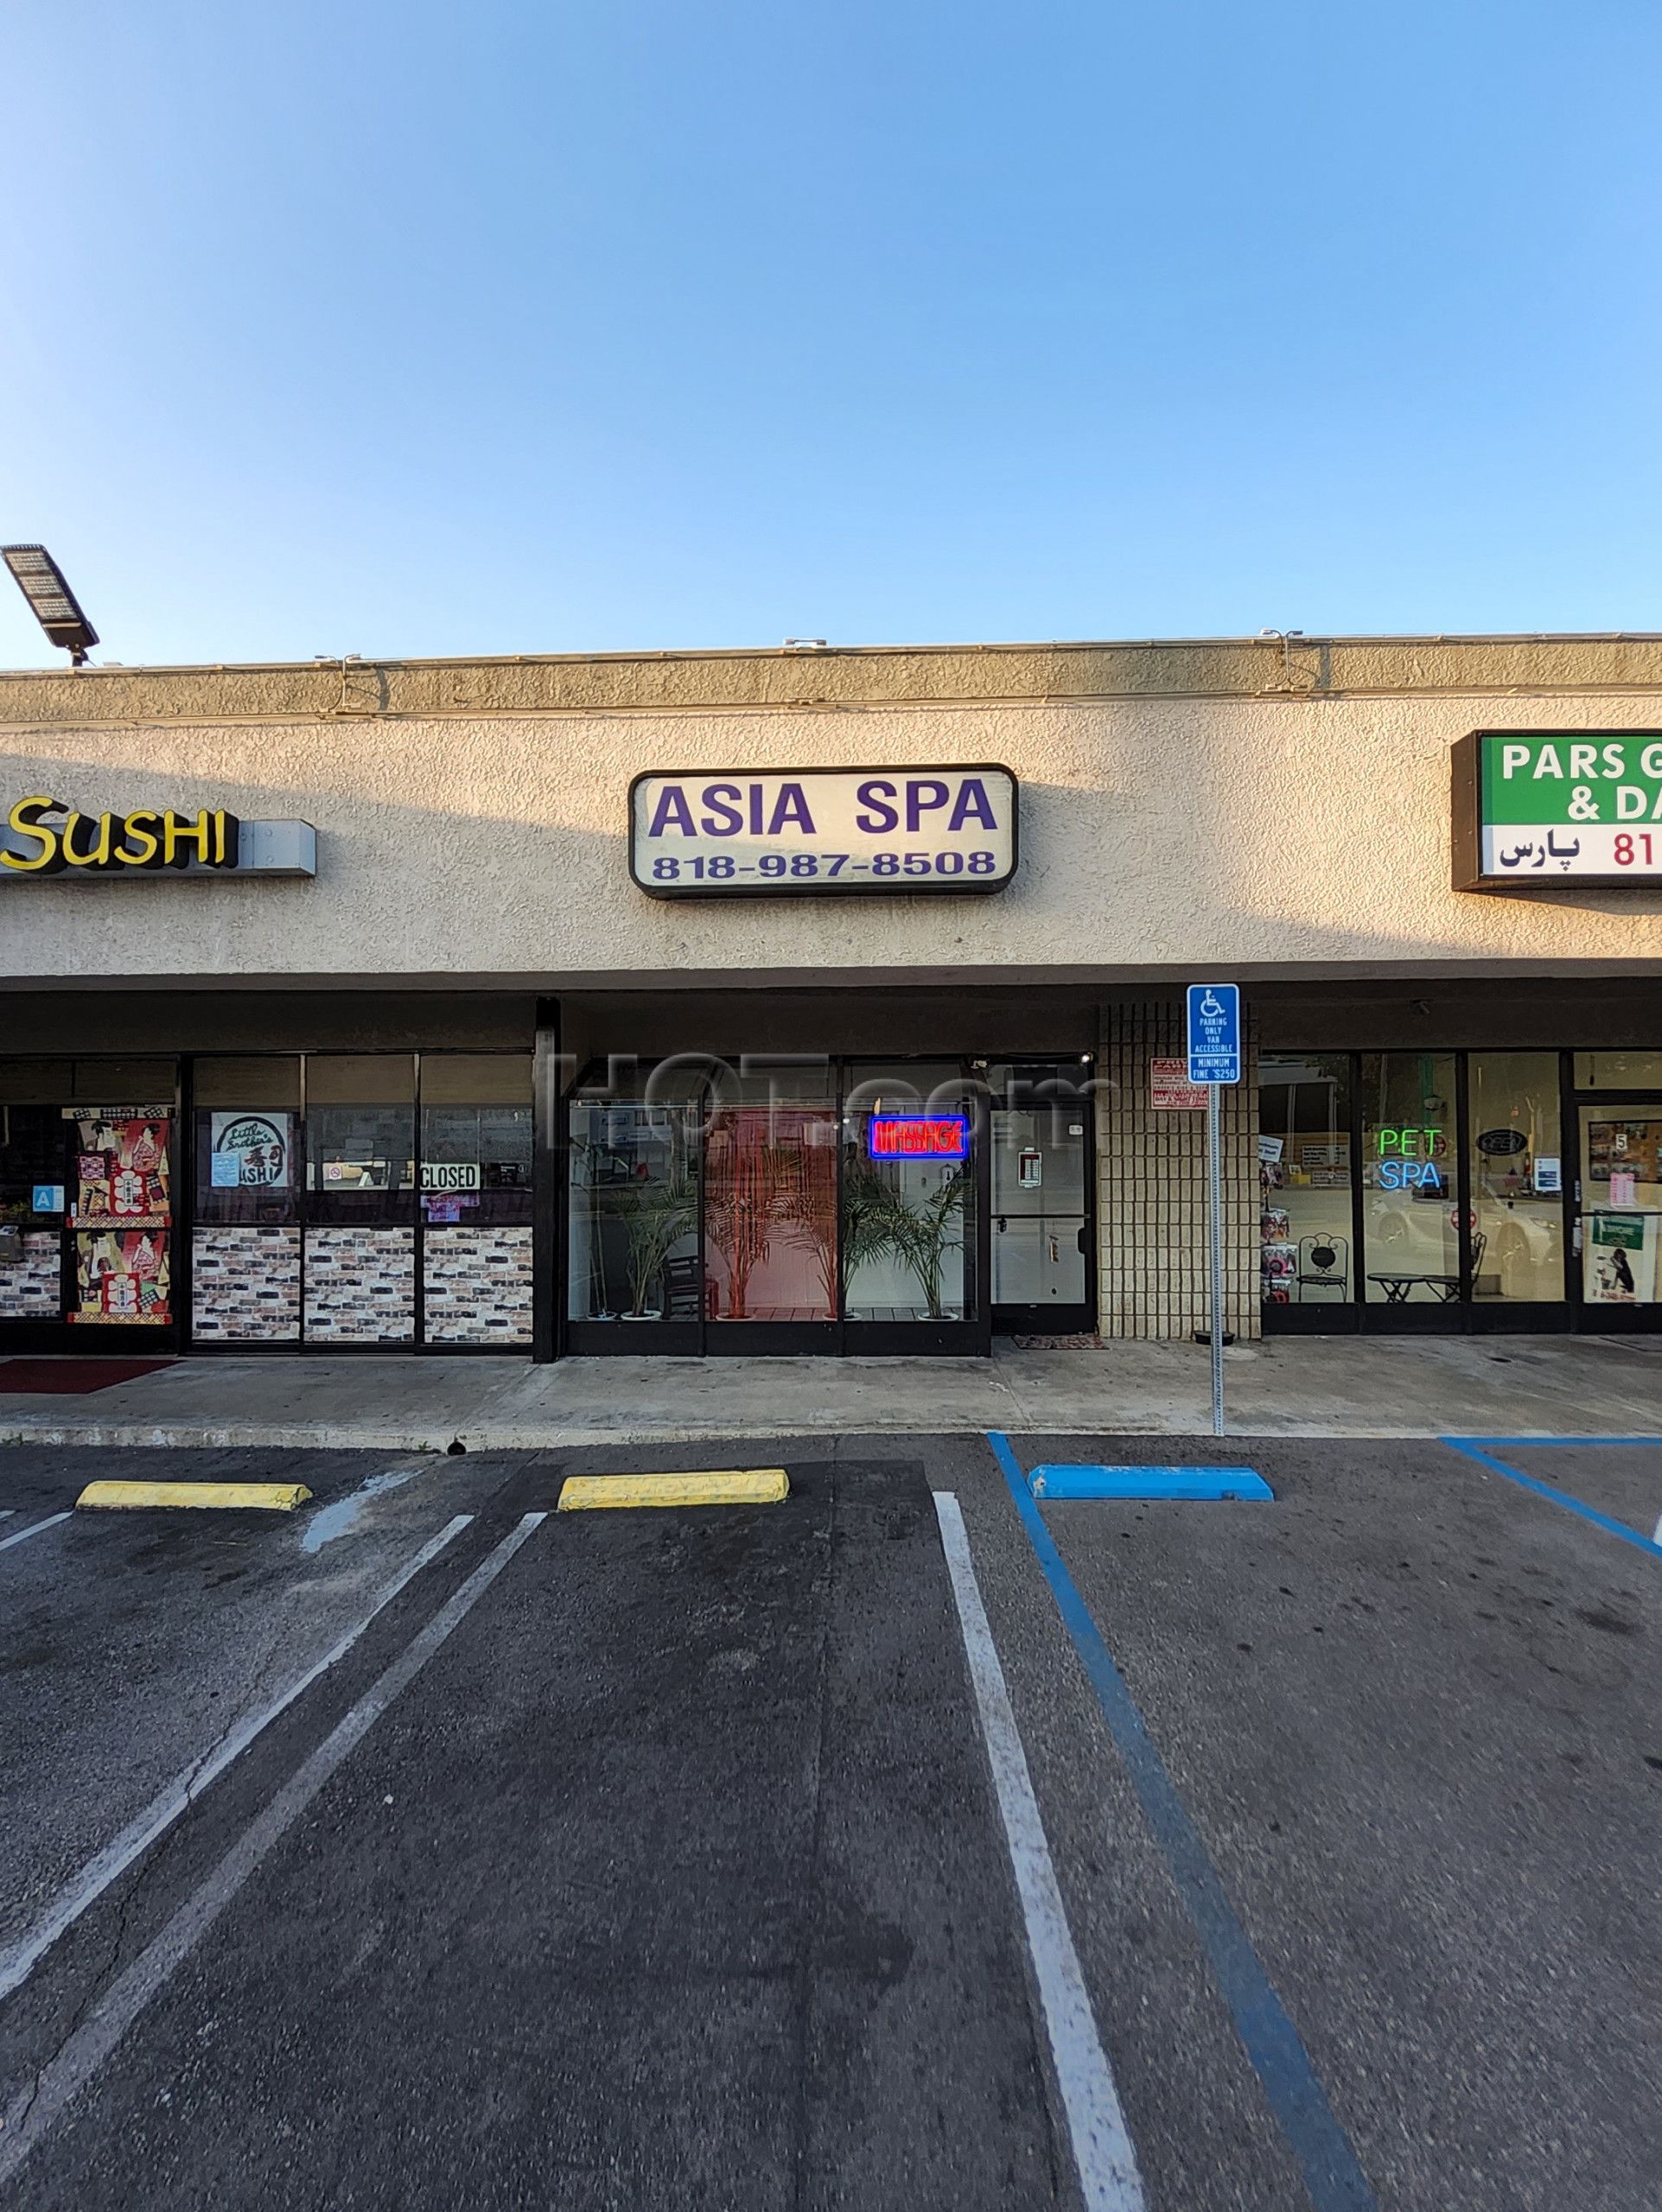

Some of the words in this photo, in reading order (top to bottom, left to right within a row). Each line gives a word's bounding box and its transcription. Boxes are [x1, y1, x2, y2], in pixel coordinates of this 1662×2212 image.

[1502, 744, 1625, 779] PARS
[648, 783, 816, 837] ASIA
[856, 779, 997, 834] SPA
[1568, 785, 1599, 820] &
[1500, 829, 1580, 872] پارس
[653, 851, 996, 880] 818-987-8508
[1200, 1018, 1227, 1027] PARKING
[1205, 1027, 1222, 1035] ONLY
[1194, 1044, 1233, 1053] ACCESSIBLE
[1193, 1069, 1209, 1079] FINE
[1198, 1058, 1230, 1068] MINIMUM
[228, 1122, 266, 1141] Little
[874, 1120, 964, 1154] MASSAGE
[1379, 1128, 1442, 1156] PET
[1617, 1135, 1626, 1149] 5
[420, 1166, 476, 1188] CLOSED
[1379, 1161, 1441, 1190] SPA
[36, 1192, 50, 1207] A
